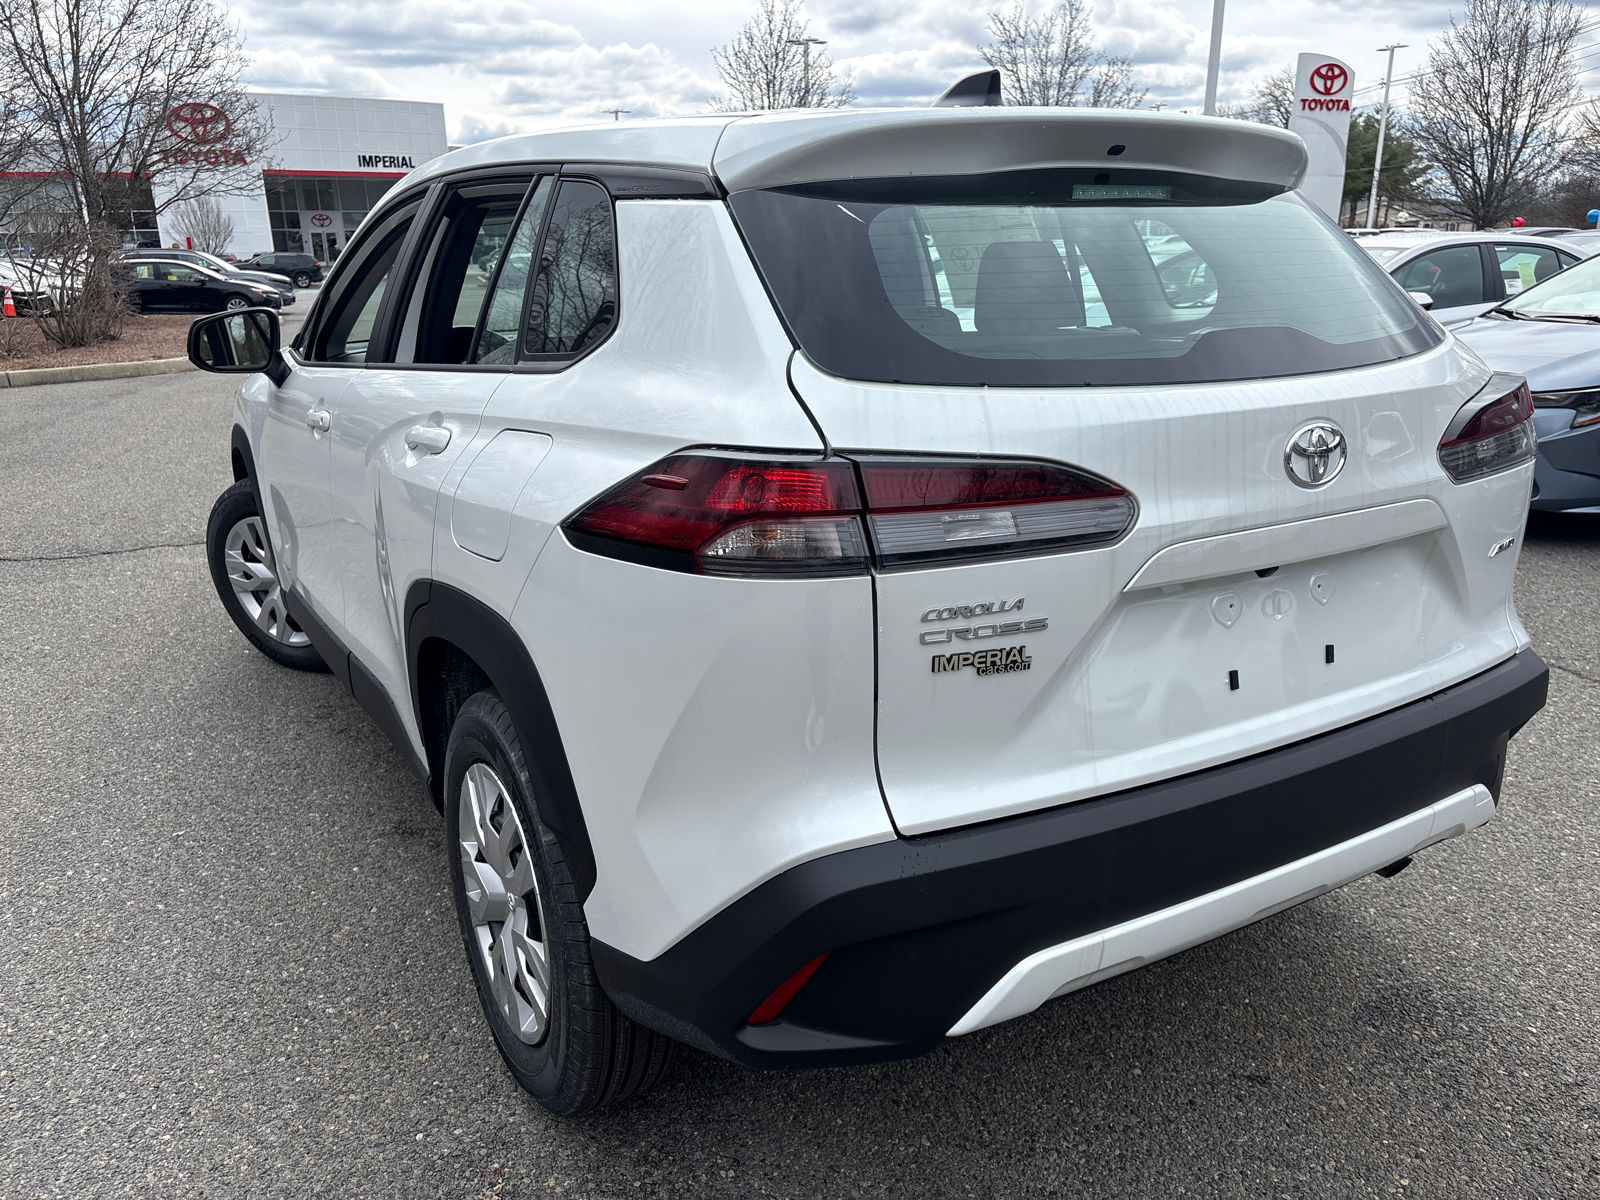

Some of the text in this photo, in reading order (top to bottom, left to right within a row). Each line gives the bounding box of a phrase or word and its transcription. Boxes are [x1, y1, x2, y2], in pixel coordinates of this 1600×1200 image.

[1300, 98, 1350, 111] TOYOTA
[357, 154, 415, 168] IMPERIAL
[920, 596, 1025, 622] COROLLA
[919, 616, 1048, 645] CROSS
[932, 646, 1032, 673] IMPERIAL
[978, 660, 1032, 676] cars.com
